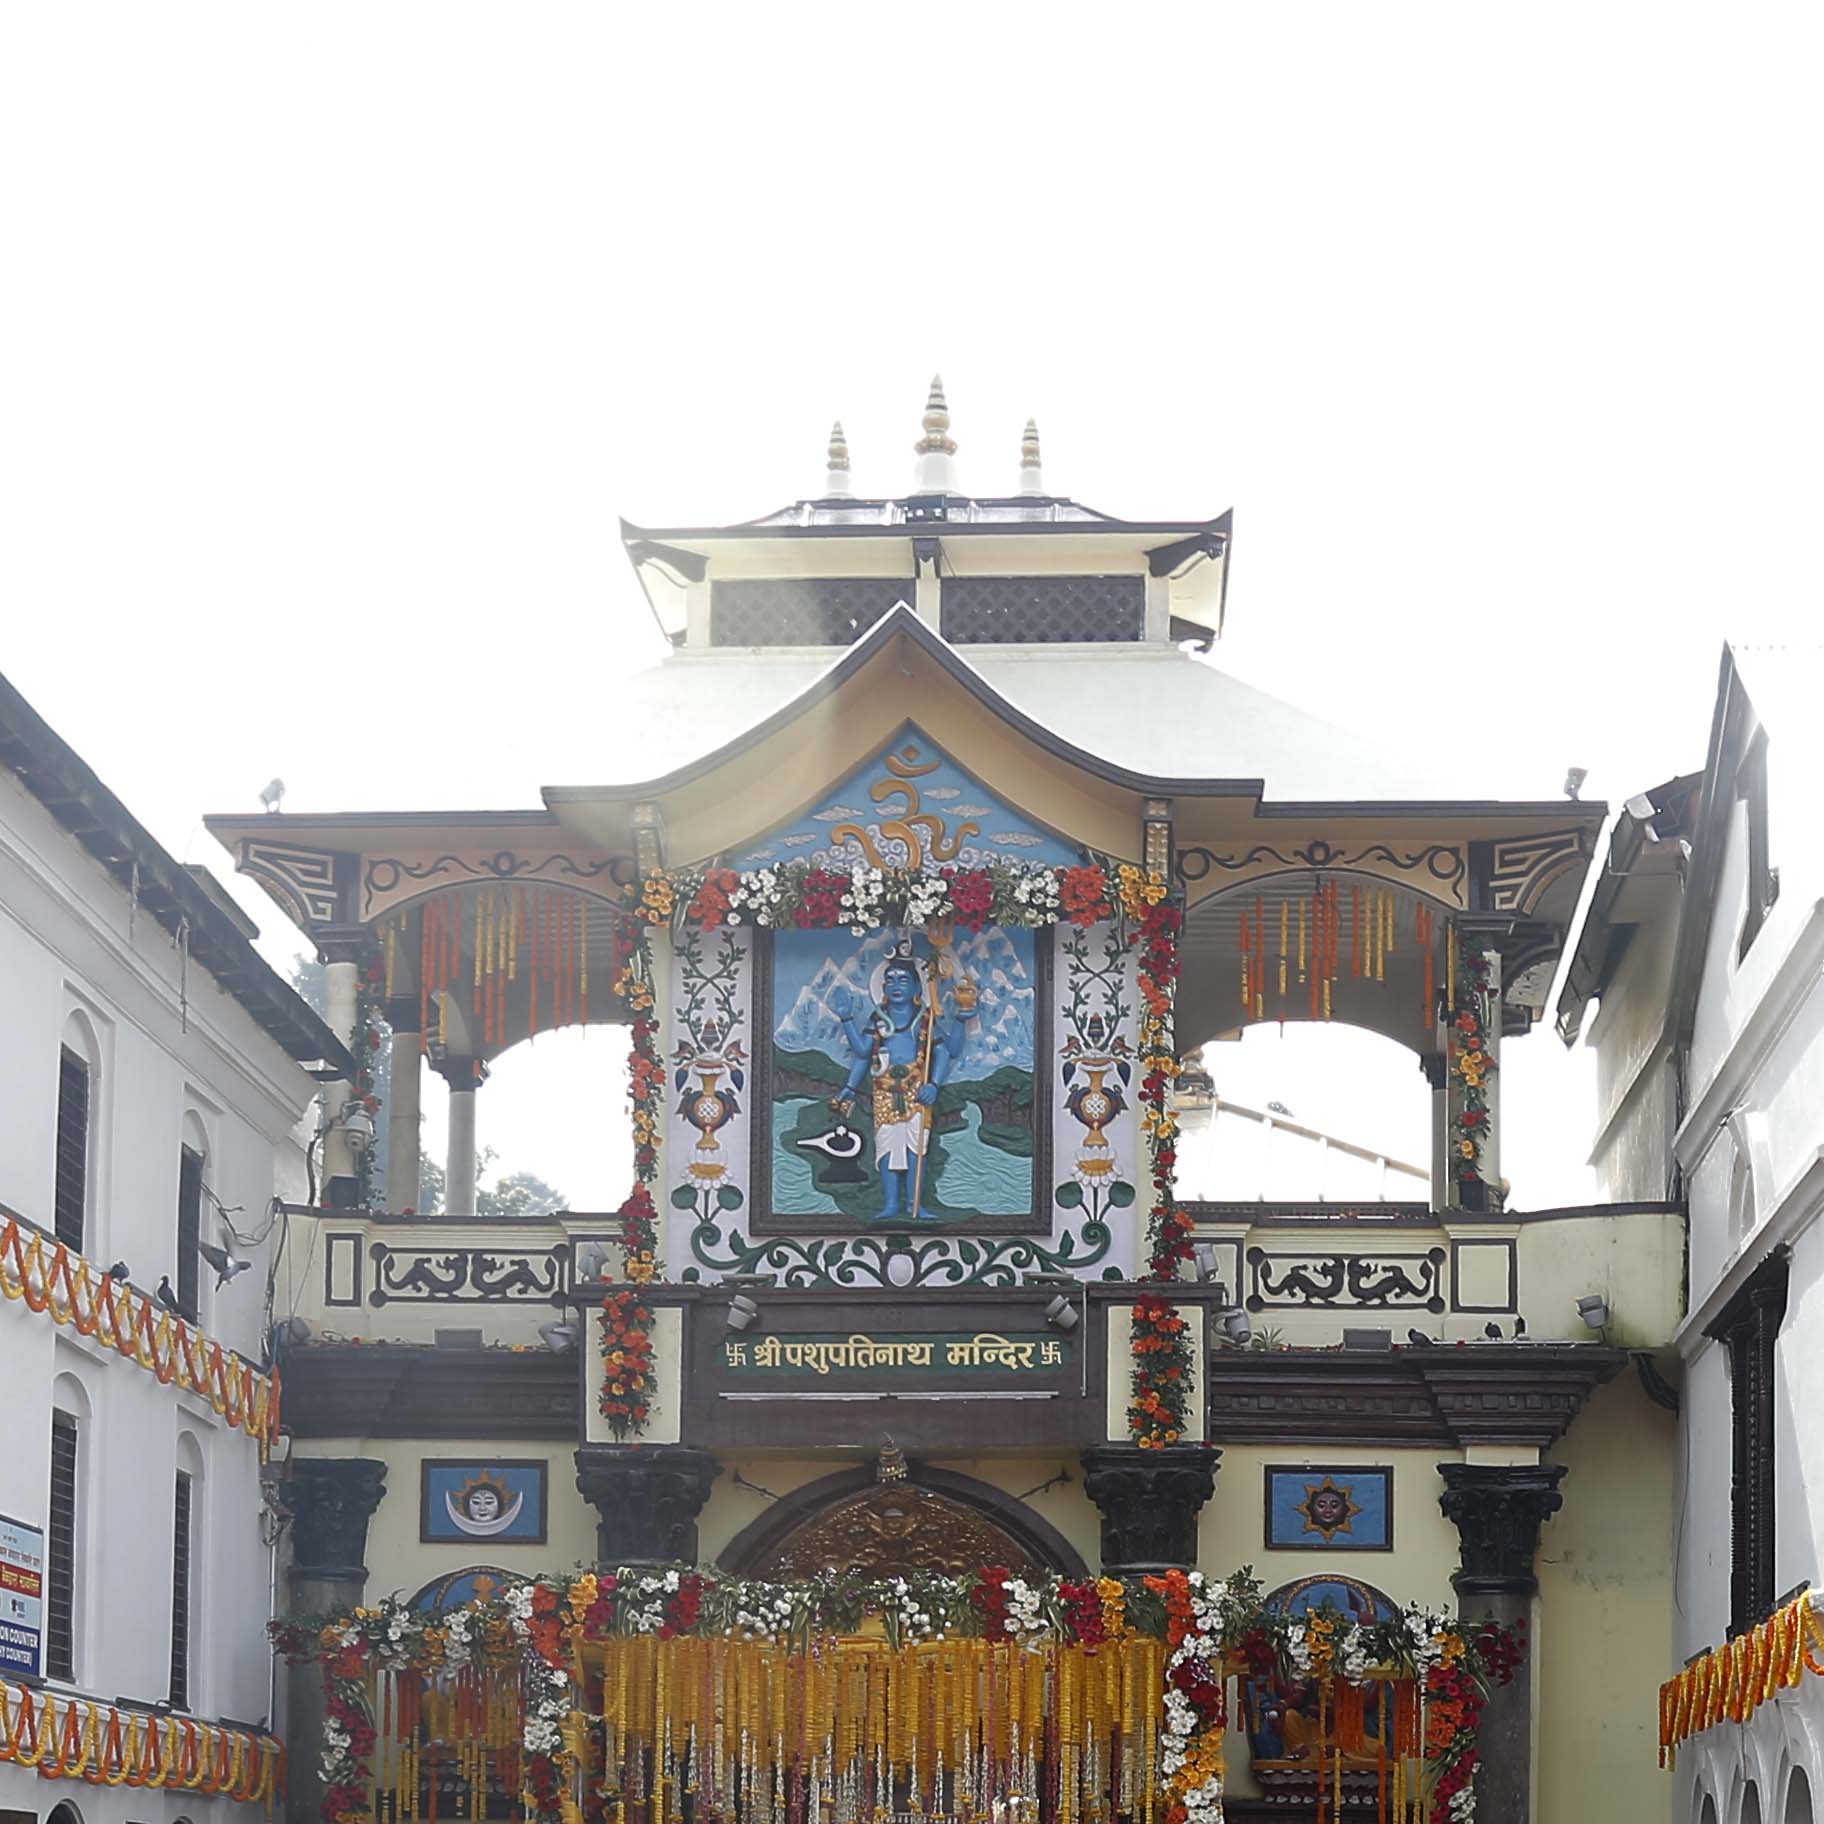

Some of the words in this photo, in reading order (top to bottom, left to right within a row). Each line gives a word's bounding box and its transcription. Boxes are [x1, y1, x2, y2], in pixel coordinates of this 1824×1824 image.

[784, 1334, 935, 1374] पशुपतिनाथ
[946, 1333, 1035, 1370] मन्दिर
[9, 1627, 39, 1648] COUNTER
